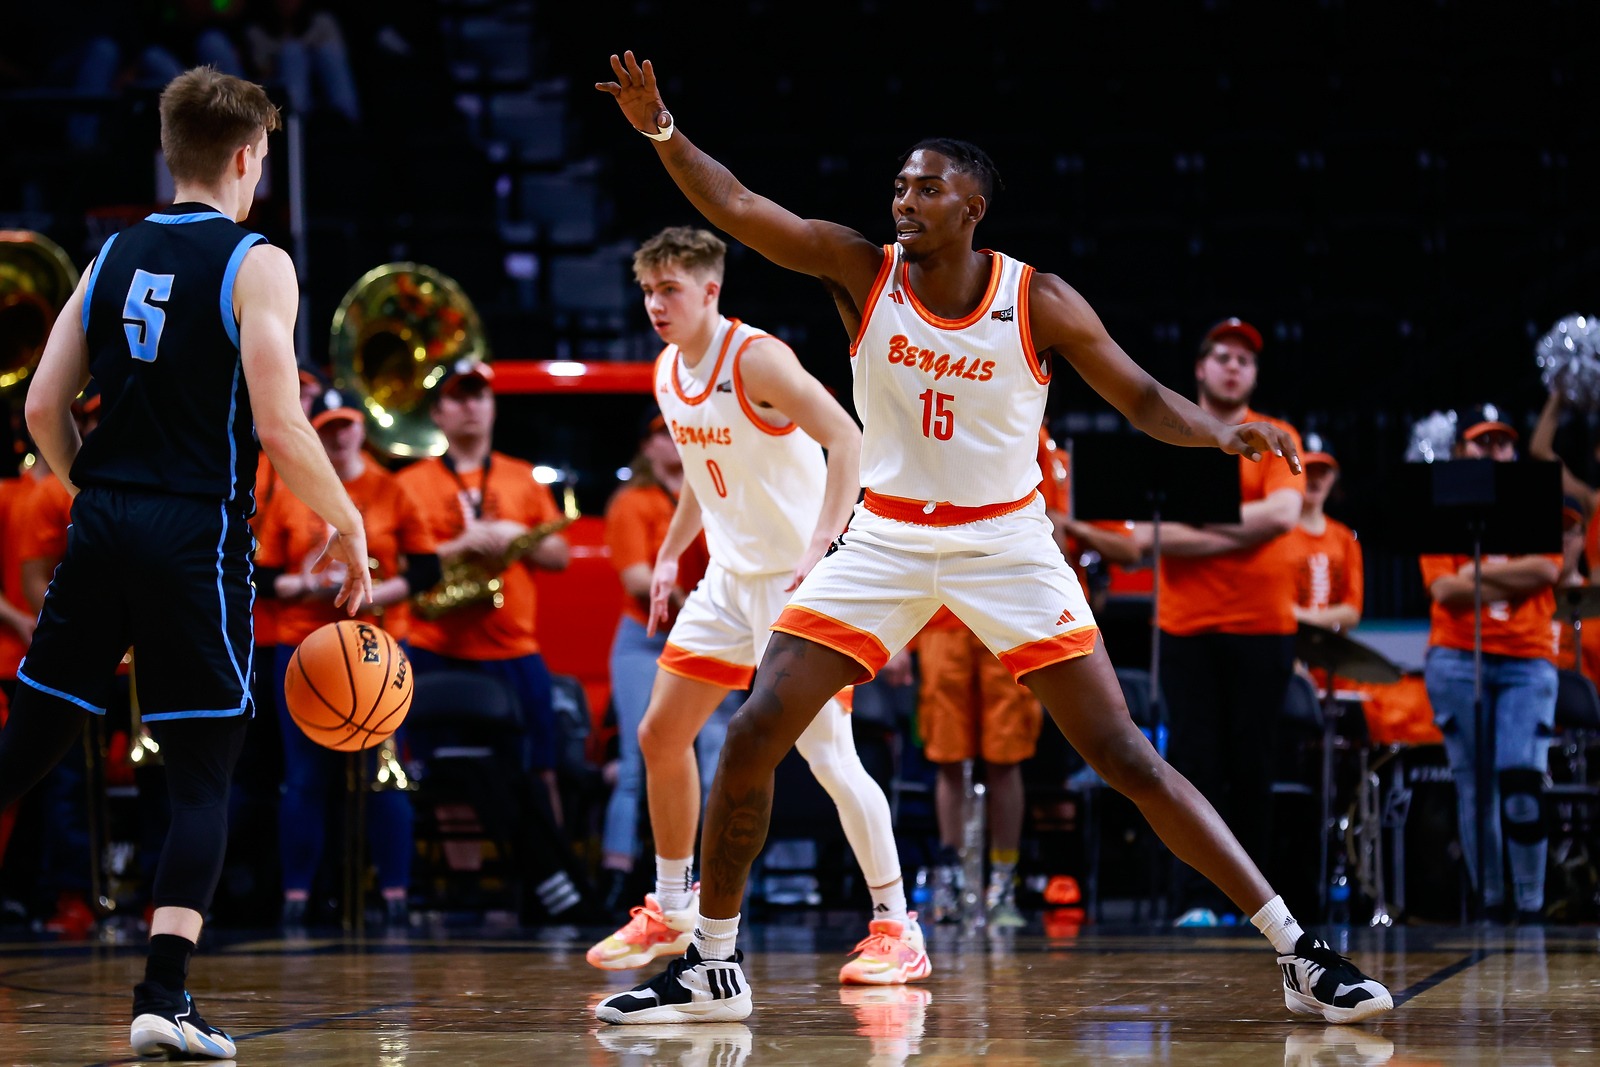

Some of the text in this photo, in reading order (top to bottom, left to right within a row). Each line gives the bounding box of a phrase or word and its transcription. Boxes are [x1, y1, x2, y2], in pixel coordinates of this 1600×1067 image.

[122, 268, 175, 363] 5
[887, 334, 996, 382] BENGALS
[919, 388, 955, 441] 15
[706, 459, 727, 498] 0
